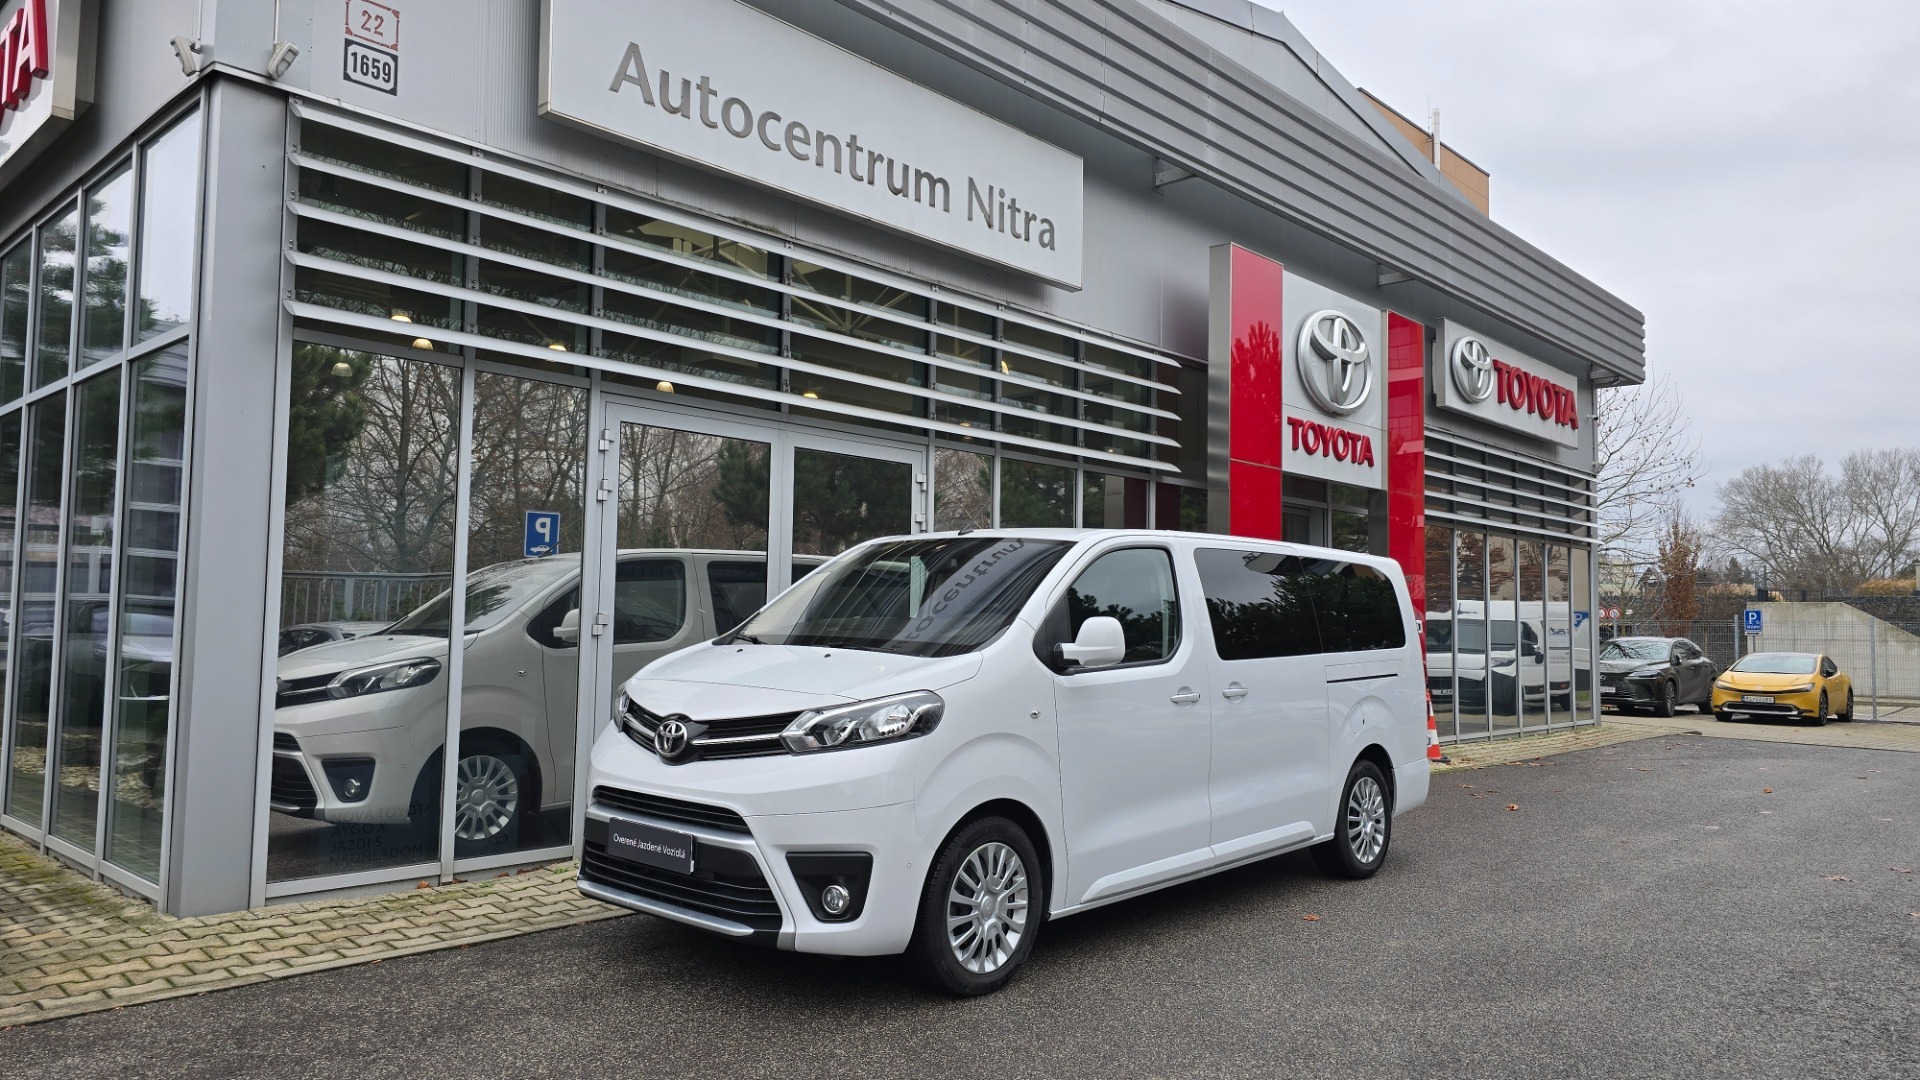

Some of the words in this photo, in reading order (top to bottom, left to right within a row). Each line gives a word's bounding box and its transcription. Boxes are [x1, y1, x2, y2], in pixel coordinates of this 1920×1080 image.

[361, 10, 384, 37] 22
[351, 52, 391, 83] 1659
[608, 41, 951, 213] Autocentrum
[967, 176, 1056, 252] Nitra
[1492, 359, 1578, 430] TOYOTA
[1287, 416, 1374, 468] TOYOTA
[1749, 612, 1757, 625] P
[613, 833, 637, 847] Overené
[637, 839, 662, 854] Jazdené
[662, 845, 686, 859] Vozidlá
